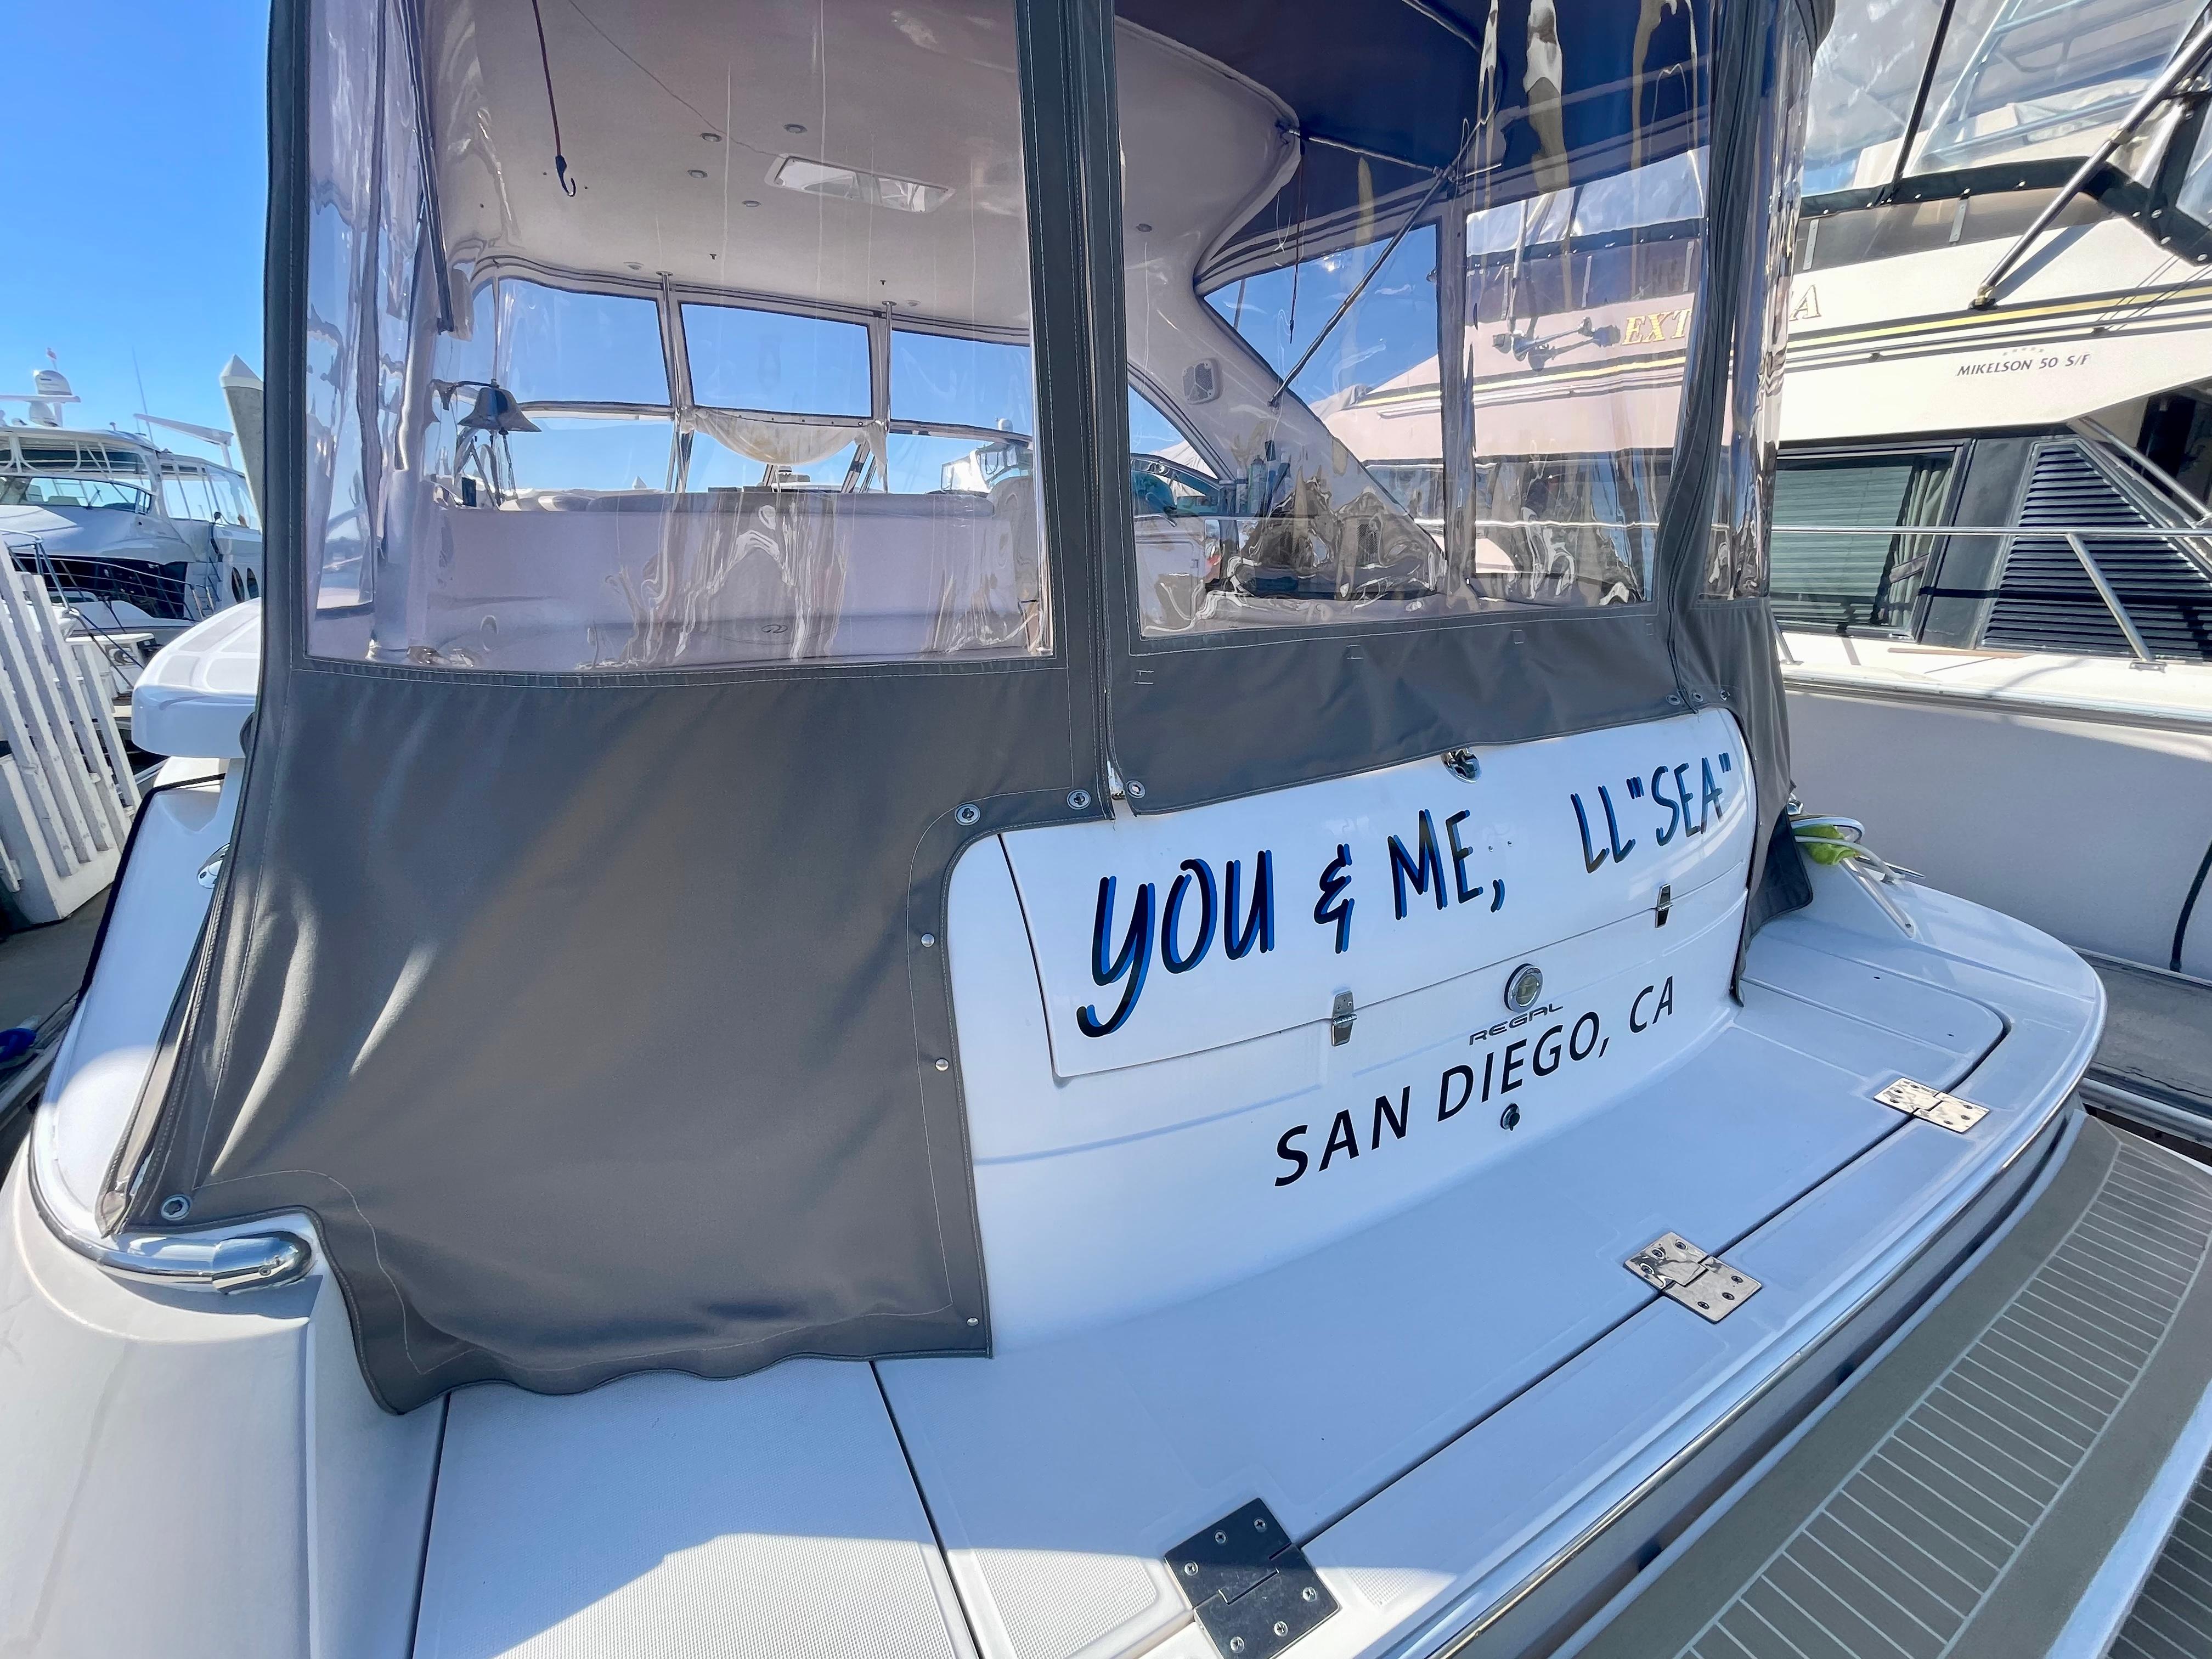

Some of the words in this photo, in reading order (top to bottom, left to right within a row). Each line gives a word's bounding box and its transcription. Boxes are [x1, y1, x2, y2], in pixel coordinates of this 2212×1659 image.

[1956, 359, 2033, 376] MIKELSON
[2038, 357, 2058, 370] 50
[2064, 353, 2091, 367] S/F
[1076, 849, 1275, 1038] YOU
[1313, 843, 1355, 955] &
[1387, 808, 1506, 921] ME,
[1274, 1085, 1411, 1187] SAN
[1437, 1011, 1610, 1122] DIEGO,
[1629, 975, 1673, 1034] CA
[1469, 1003, 1564, 1046] REGAL
